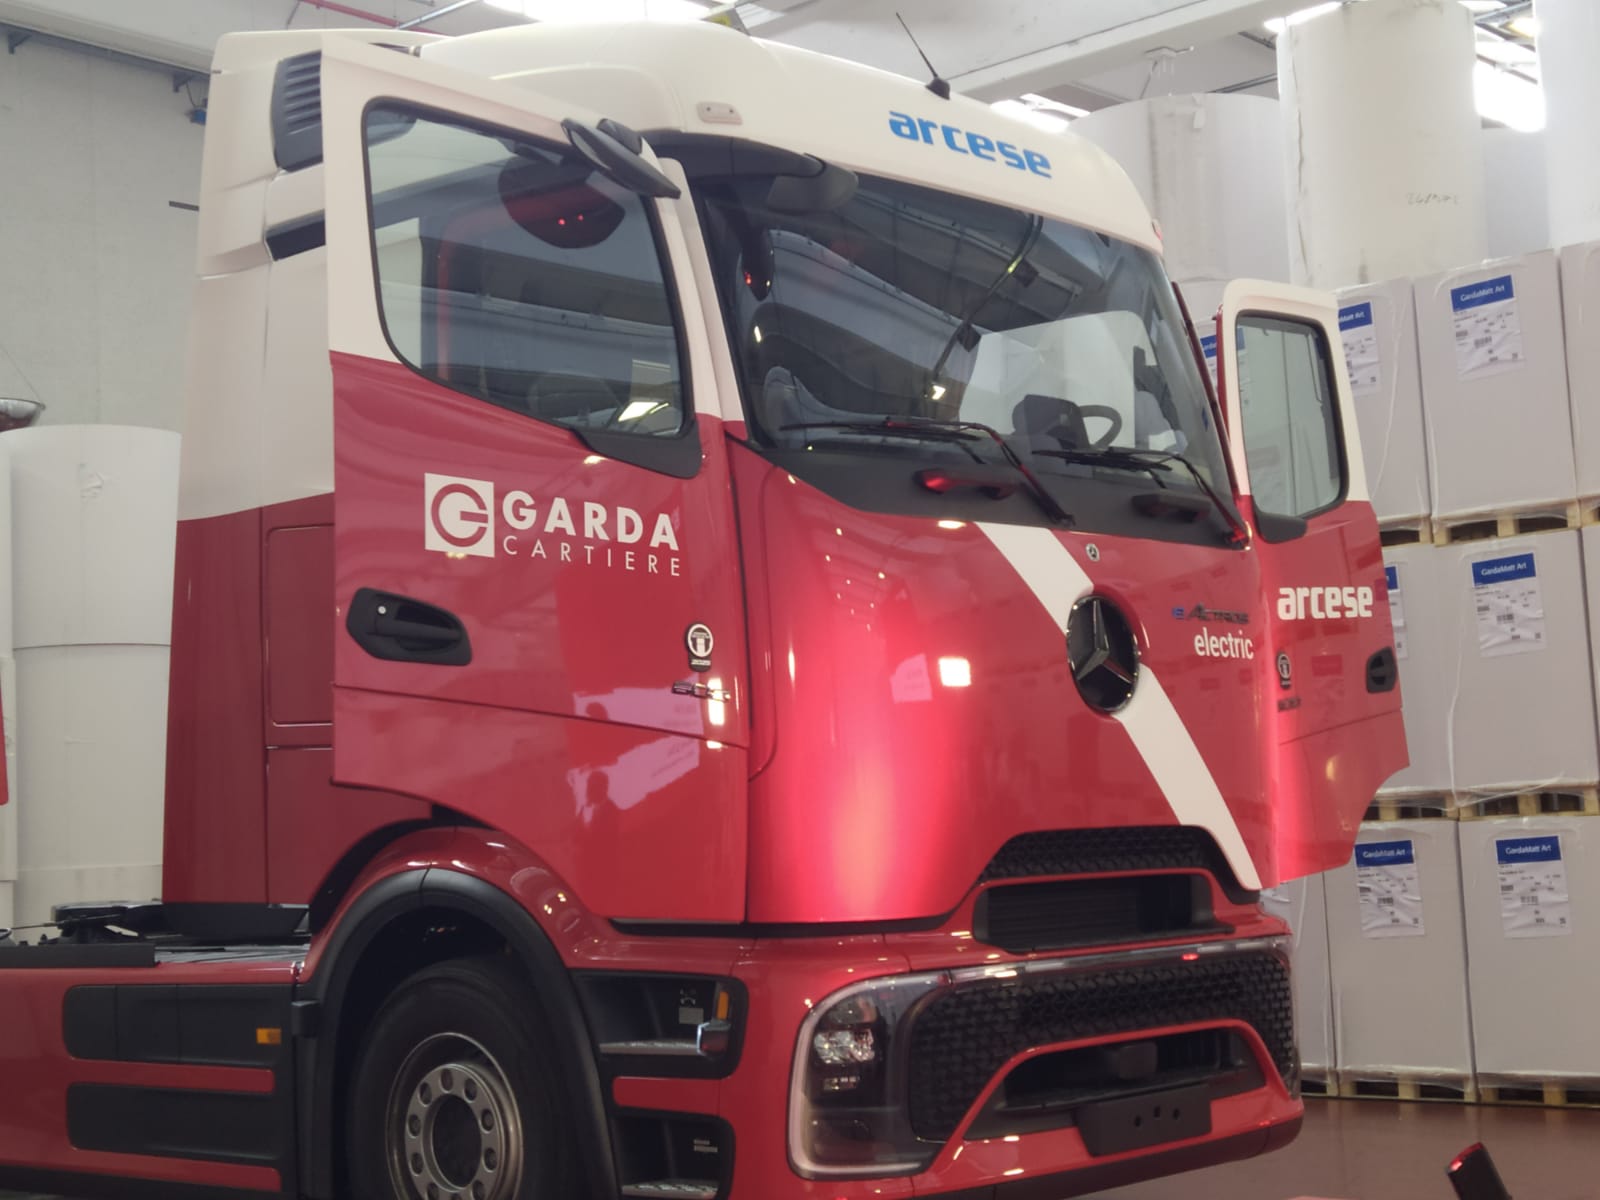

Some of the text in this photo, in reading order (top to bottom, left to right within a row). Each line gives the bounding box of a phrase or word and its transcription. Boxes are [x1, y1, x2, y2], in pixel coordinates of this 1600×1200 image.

[888, 110, 1052, 178] arcese
[502, 490, 680, 551] GARDA
[503, 535, 681, 577] CARTIERE
[1277, 587, 1373, 620] arcese
[1194, 627, 1254, 659] electric
